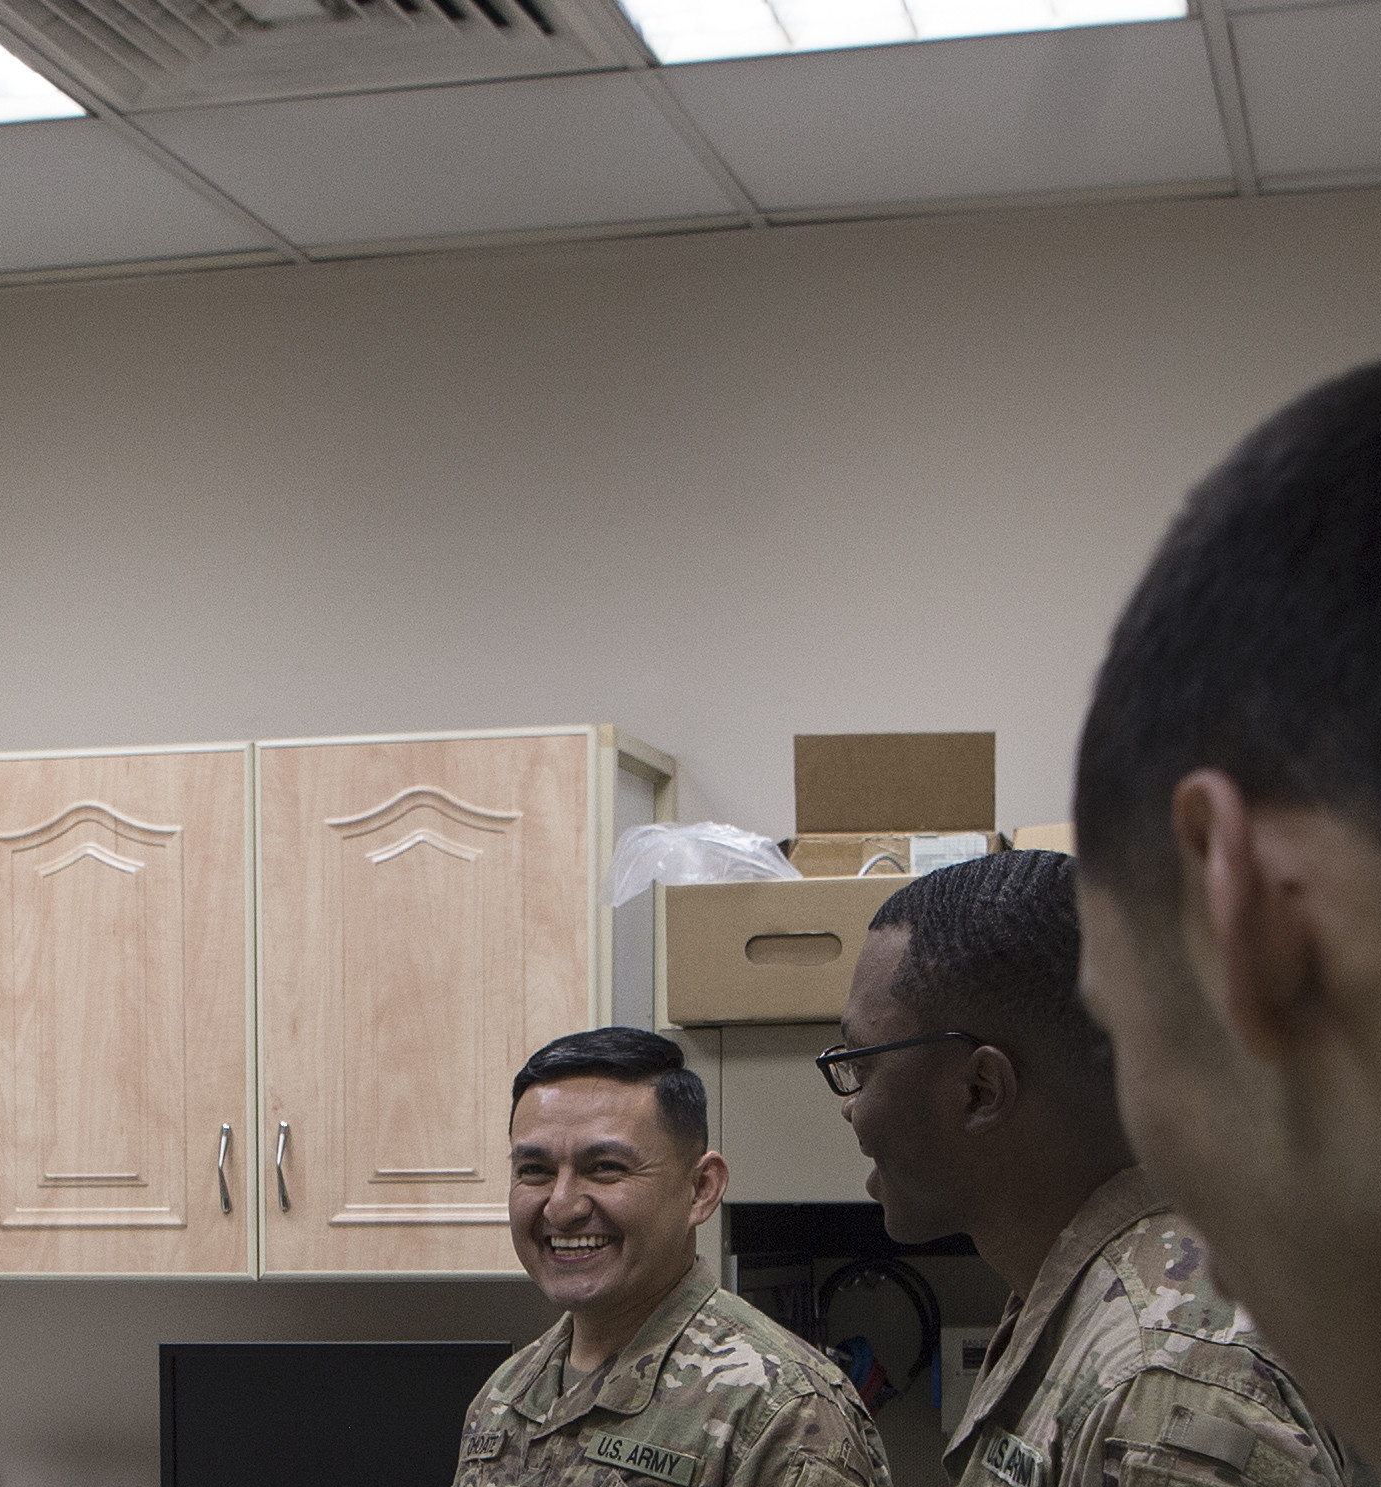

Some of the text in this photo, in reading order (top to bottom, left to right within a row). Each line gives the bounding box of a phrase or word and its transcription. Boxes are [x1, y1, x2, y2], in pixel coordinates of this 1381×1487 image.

[597, 1436, 681, 1476] U.S. ARMY
[1004, 1446, 1035, 1487] ARM
